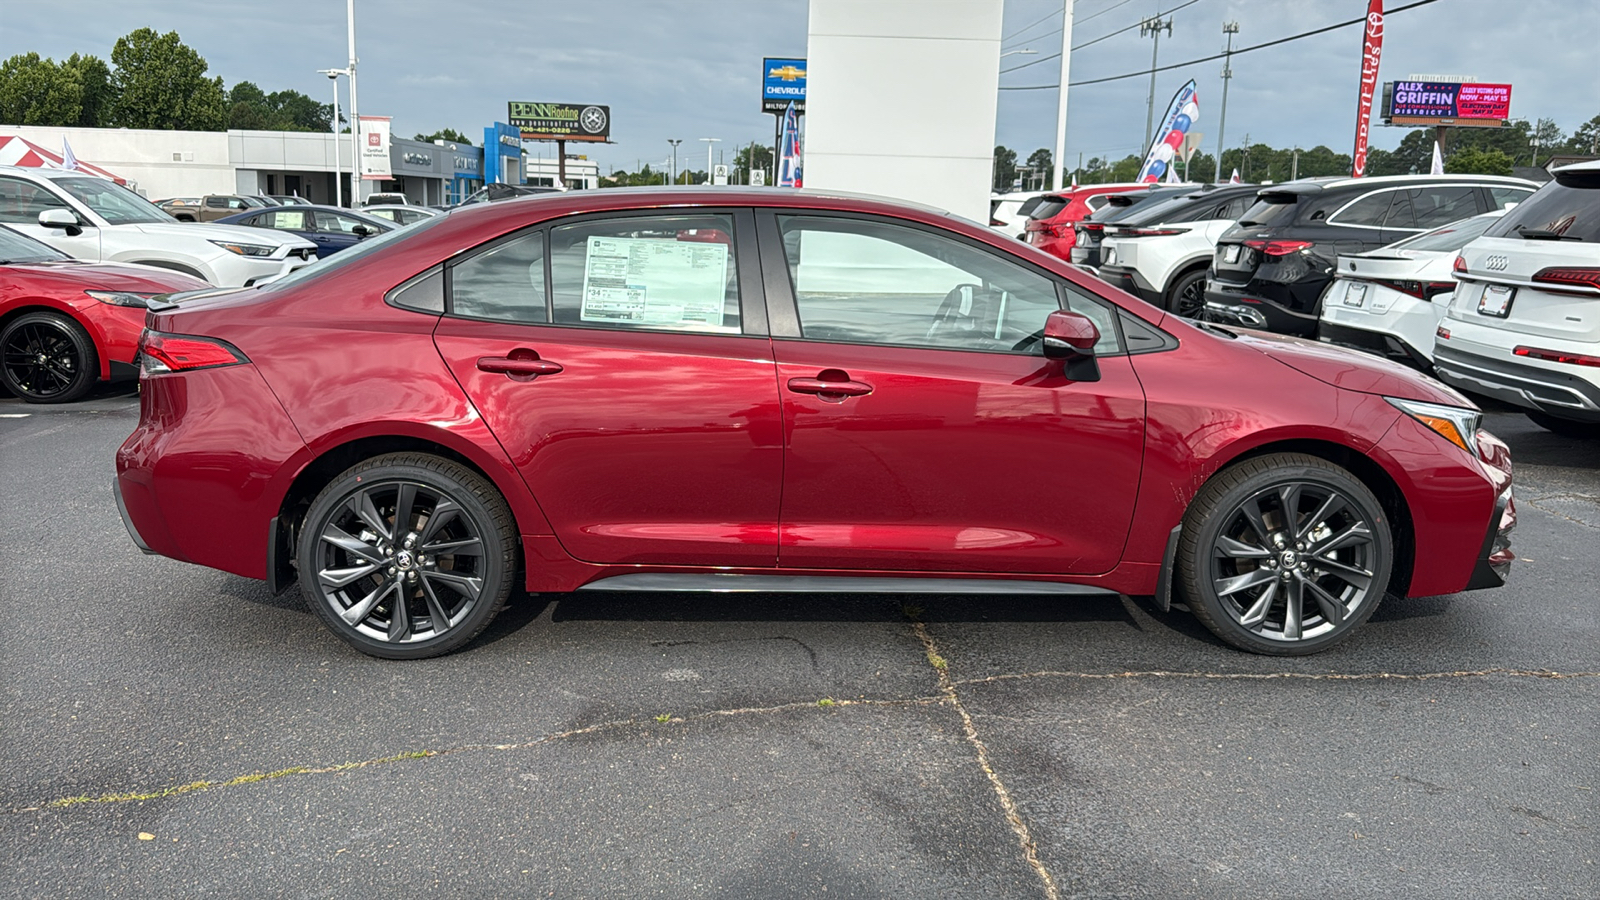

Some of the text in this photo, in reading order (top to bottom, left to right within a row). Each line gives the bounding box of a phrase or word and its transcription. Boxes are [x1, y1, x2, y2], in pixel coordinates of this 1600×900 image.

[766, 86, 806, 95] CHEVROLE
[1396, 82, 1423, 92] ALEX
[1396, 92, 1453, 104] GRIFFIN
[511, 102, 558, 117] PENN
[551, 106, 579, 121] Roofing
